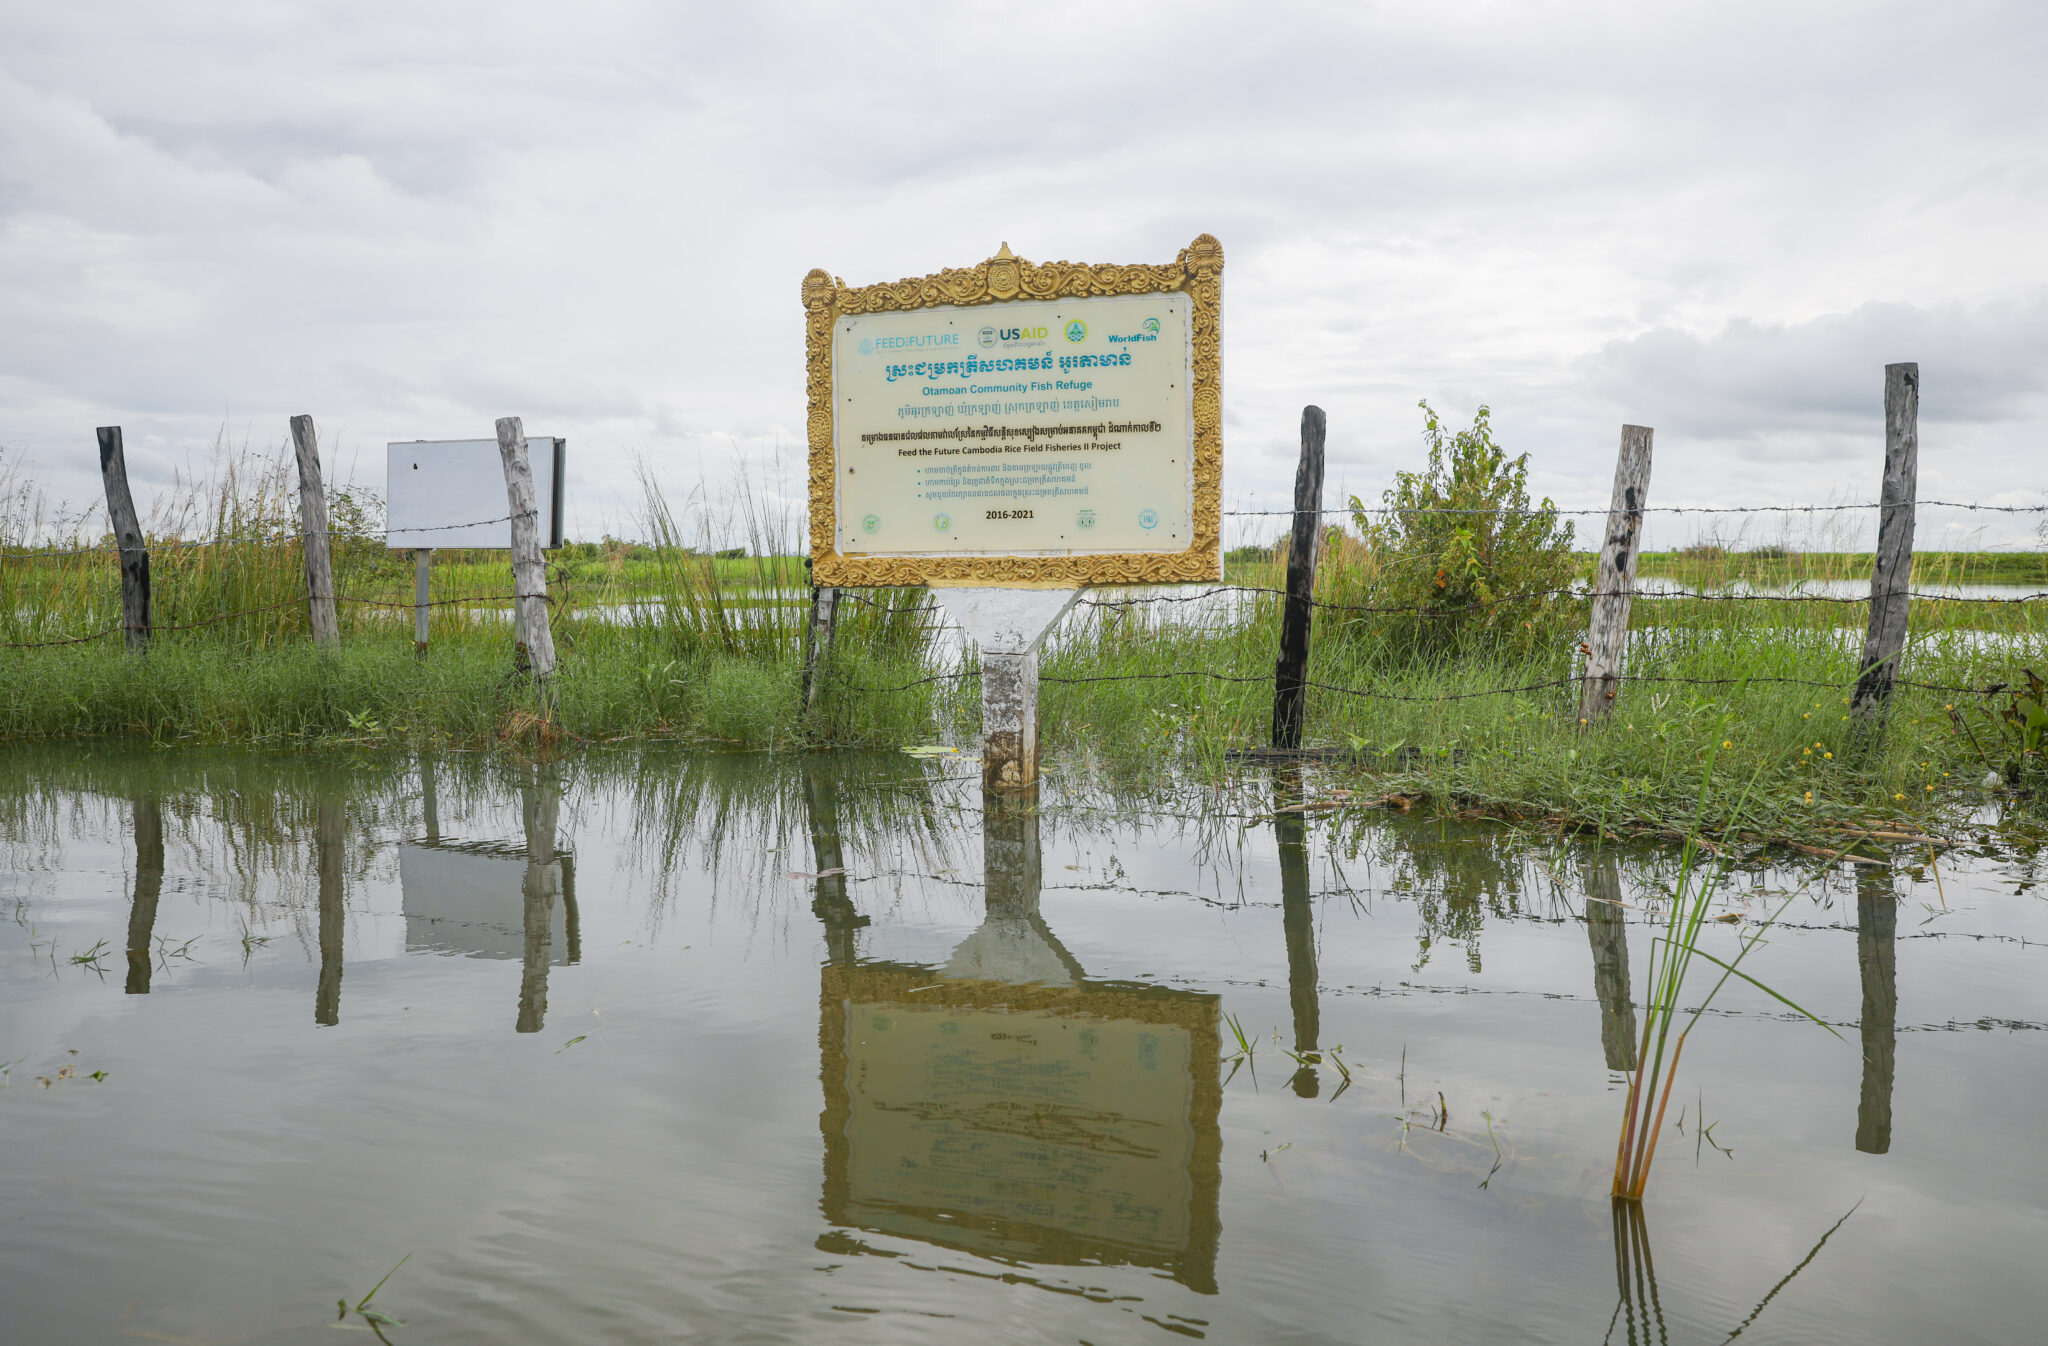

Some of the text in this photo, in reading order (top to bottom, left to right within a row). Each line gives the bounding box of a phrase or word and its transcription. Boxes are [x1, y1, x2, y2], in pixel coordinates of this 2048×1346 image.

[875, 337, 905, 350] FEED
[909, 333, 960, 347] FUTURE
[1000, 327, 1049, 341] USAID
[1108, 333, 1157, 344] WorldFish
[922, 380, 1093, 396] Otamoan Community Fish Refuge
[898, 441, 1122, 457] Feed the Future Cambodia Rice Field Fisheries II Project
[985, 509, 1034, 520] 2016-2021
